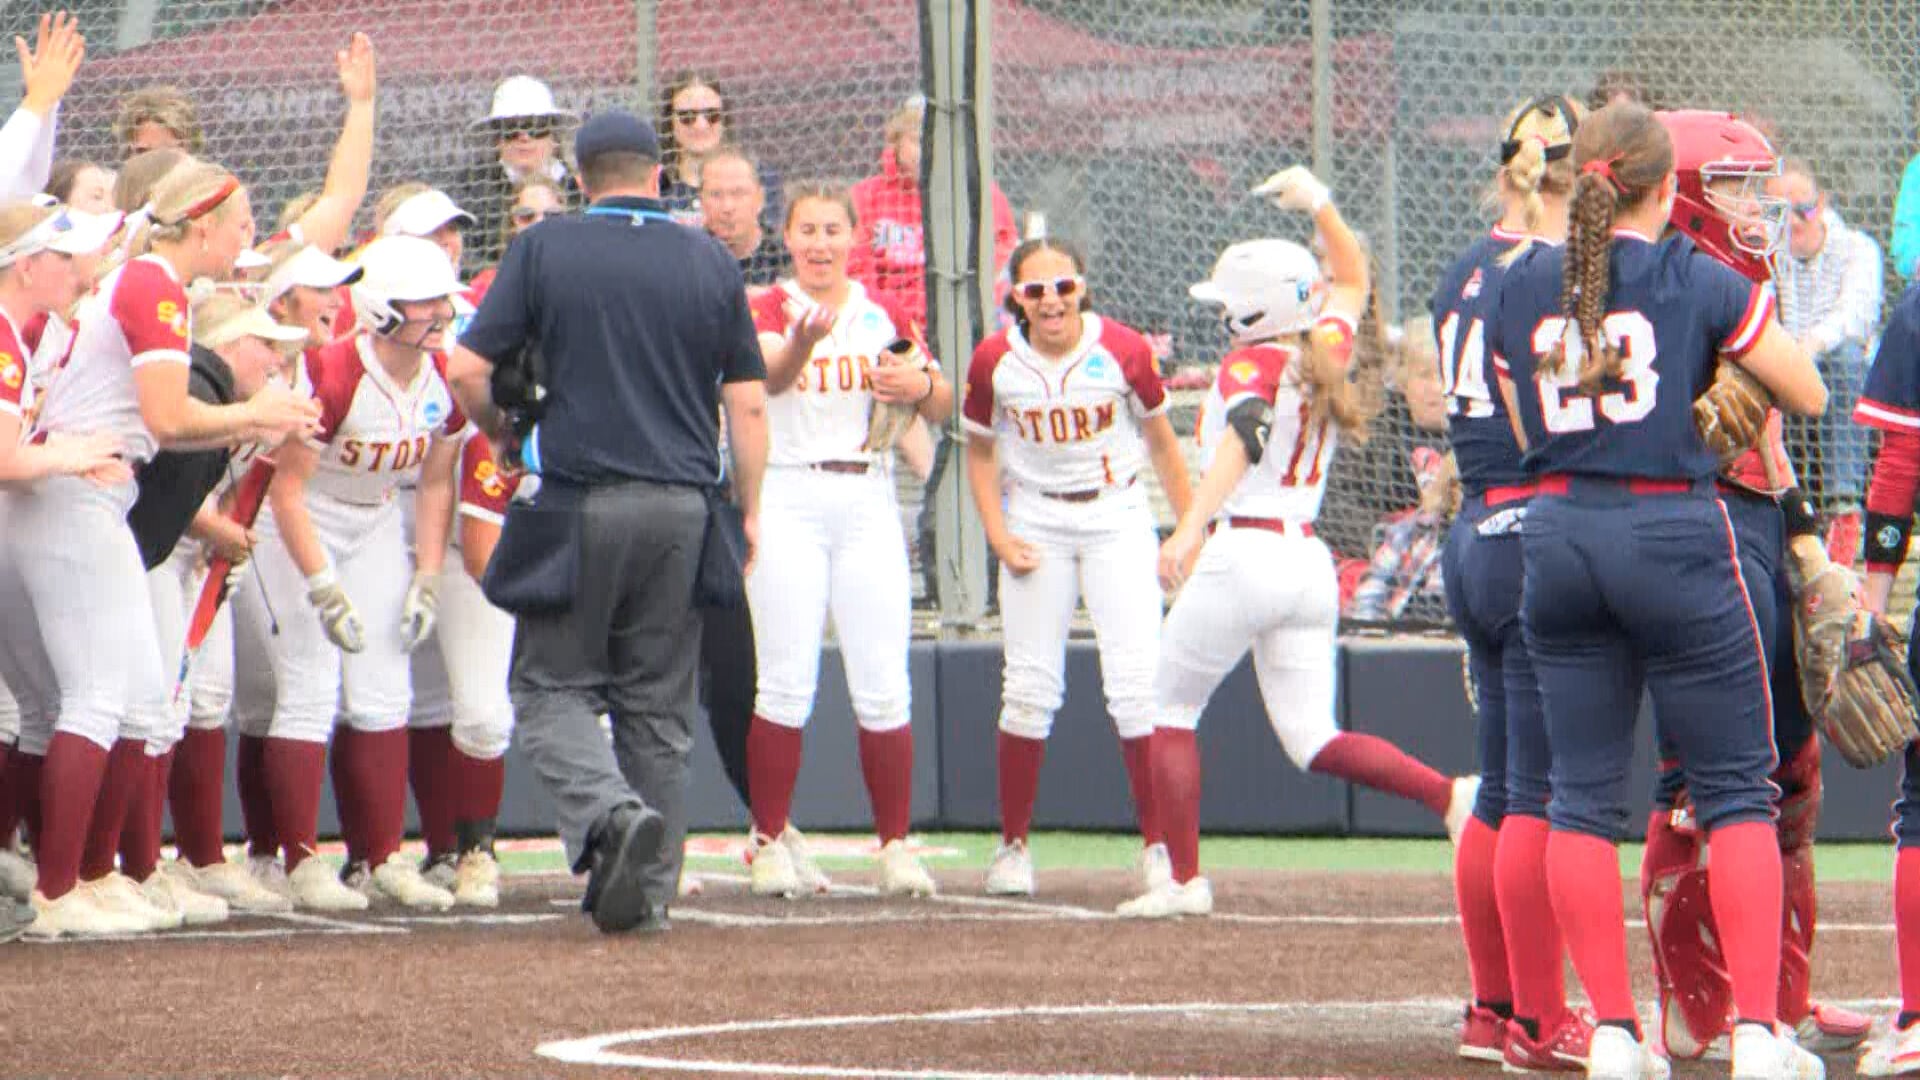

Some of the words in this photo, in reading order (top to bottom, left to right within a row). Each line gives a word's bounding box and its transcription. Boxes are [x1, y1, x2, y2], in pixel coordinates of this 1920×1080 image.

[1440, 311, 1495, 418] 14
[1530, 309, 1660, 435] 23
[1009, 401, 1115, 443] STORM
[1280, 400, 1327, 487] 11
[1101, 454, 1114, 485] 1
